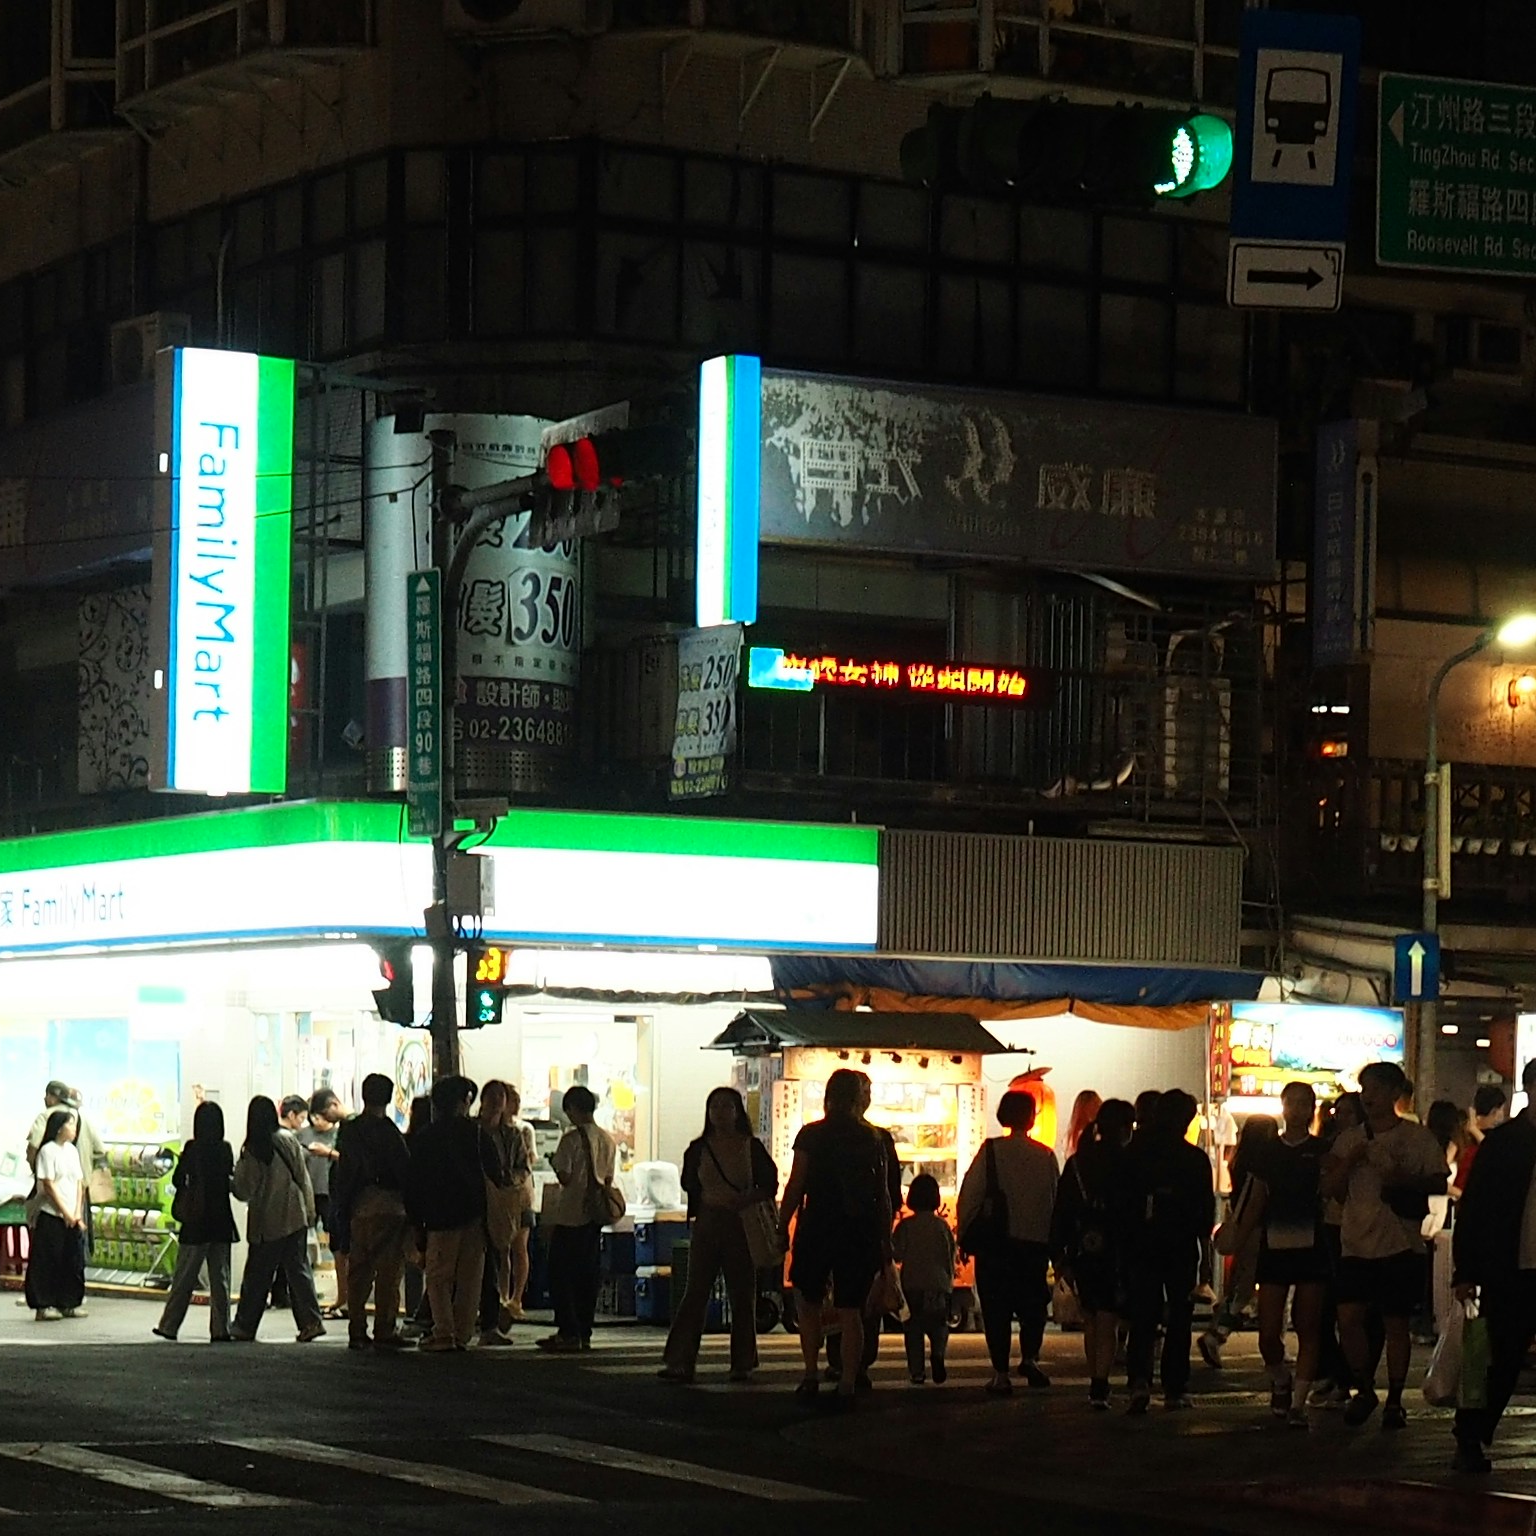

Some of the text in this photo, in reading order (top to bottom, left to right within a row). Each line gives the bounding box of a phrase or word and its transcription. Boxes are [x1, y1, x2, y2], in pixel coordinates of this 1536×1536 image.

[1410, 142, 1476, 170] TingZhou
[1407, 229, 1478, 256] Roosevelt
[189, 421, 241, 723] FamilyMart
[514, 572, 574, 647] 350
[703, 654, 734, 690] 250
[702, 695, 731, 736] 350
[22, 881, 125, 930] FamilyMart
